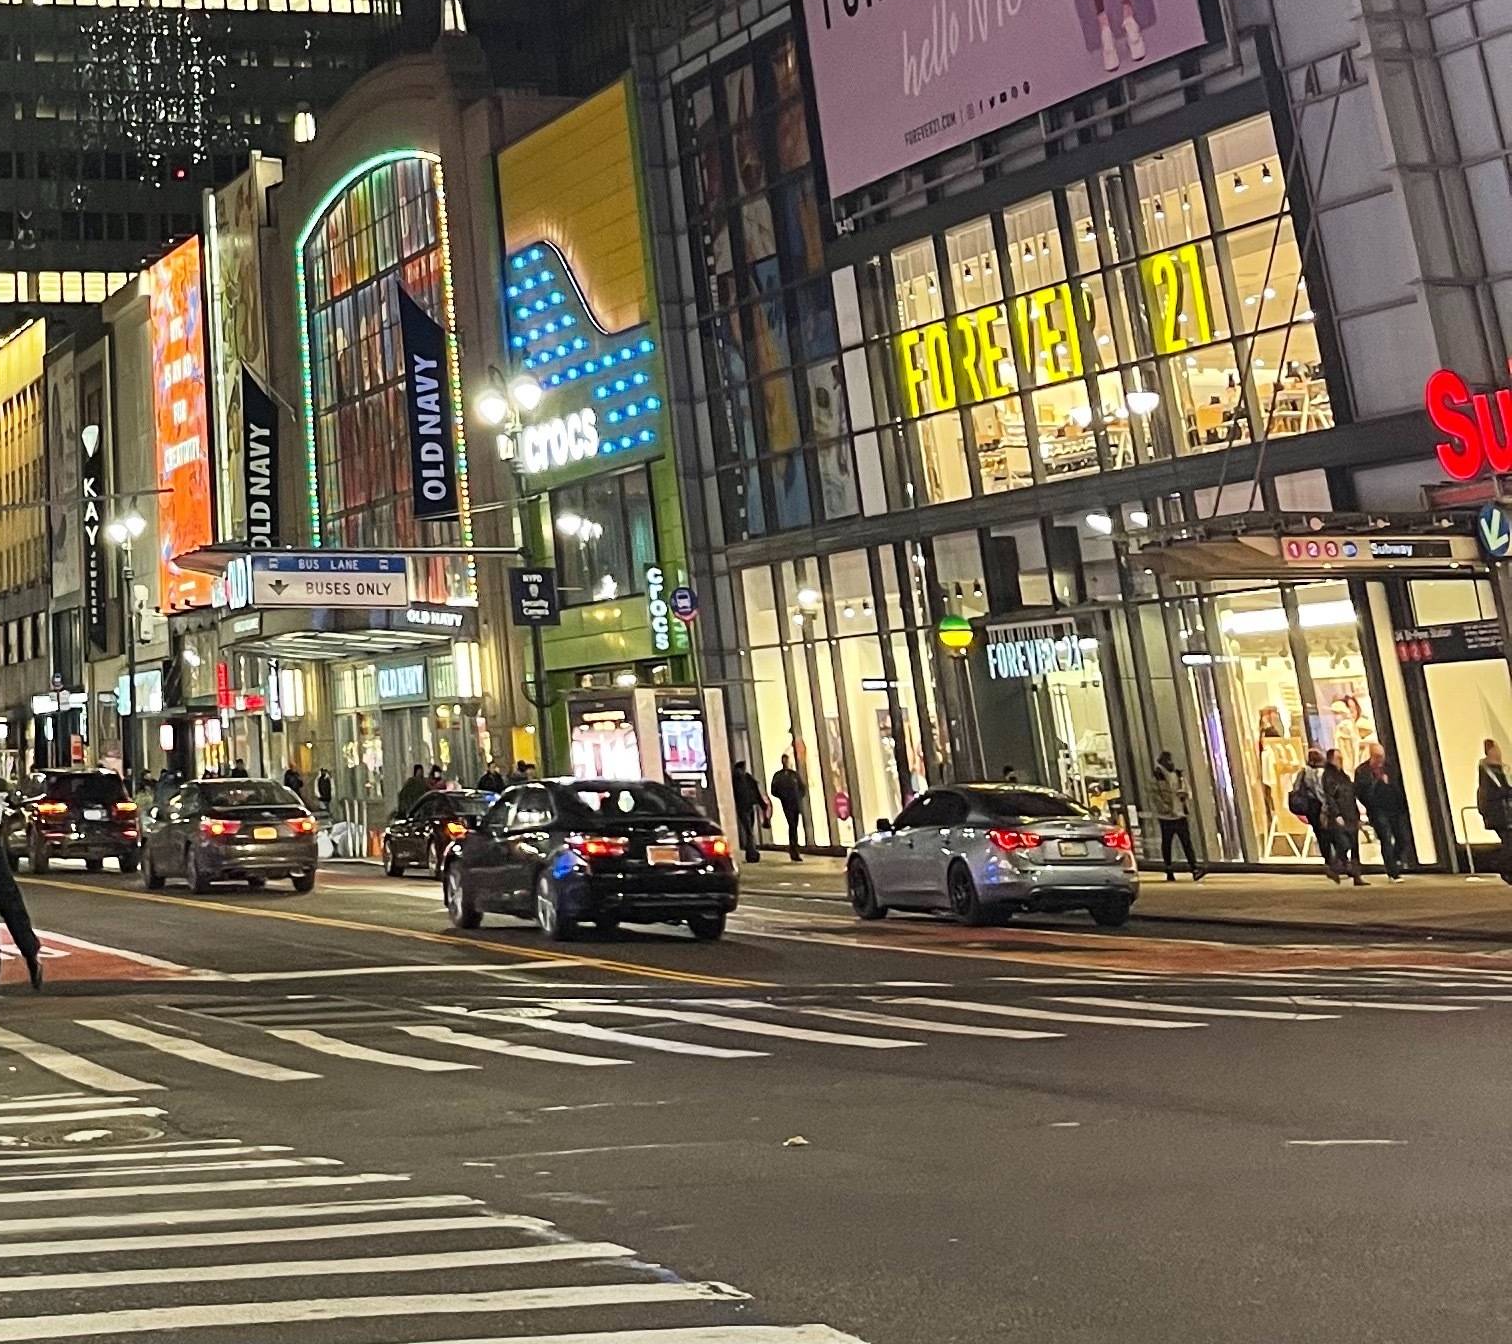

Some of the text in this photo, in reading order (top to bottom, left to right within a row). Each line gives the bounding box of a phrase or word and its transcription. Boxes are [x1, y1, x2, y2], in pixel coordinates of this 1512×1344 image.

[1153, 244, 1212, 354] 21
[413, 354, 447, 501] OLD NAVY
[523, 408, 599, 473] crocs
[1425, 357, 1512, 481] Su
[83, 477, 99, 546] KAY
[249, 423, 272, 548] OLD NAVY
[298, 559, 359, 570] BUS LANE
[1370, 543, 1413, 557] Subway
[306, 582, 392, 596] BUSES ONLY
[406, 609, 463, 627] OLD NAVY
[646, 567, 670, 650] crocs
[379, 668, 397, 698] OLD
[987, 638, 1060, 680] FOREVER
